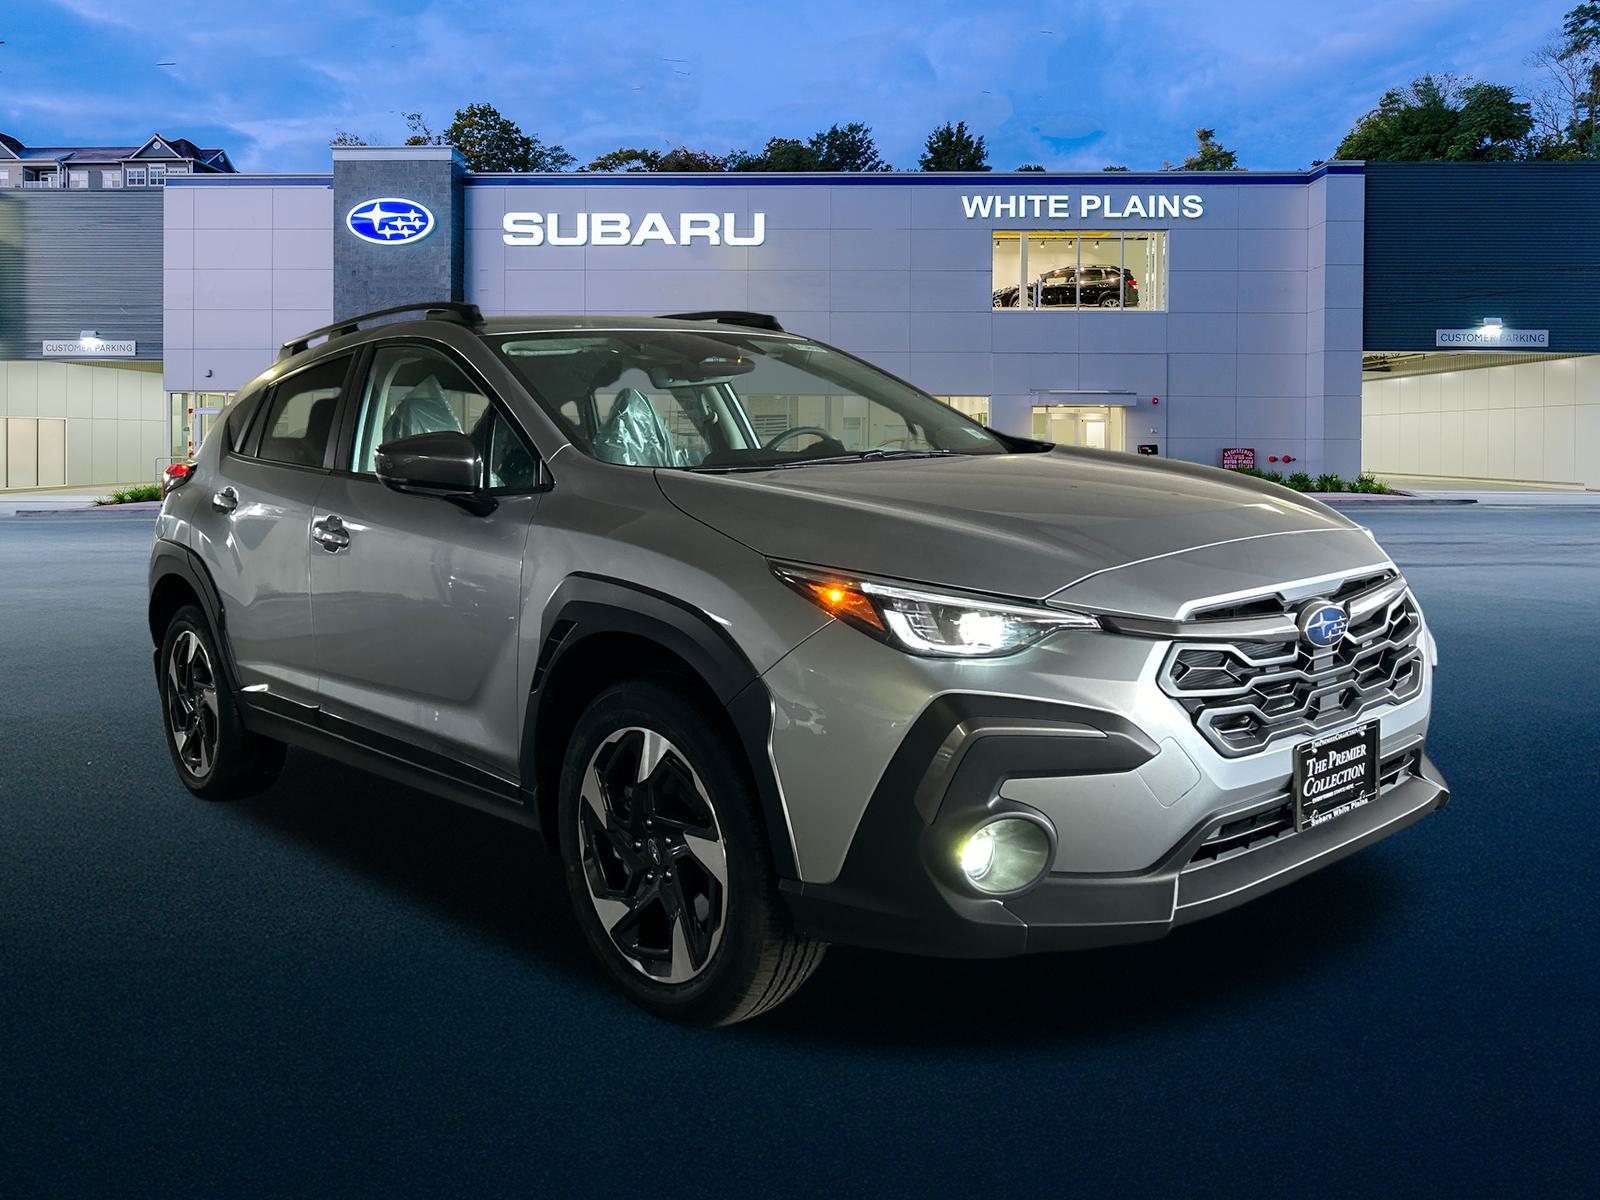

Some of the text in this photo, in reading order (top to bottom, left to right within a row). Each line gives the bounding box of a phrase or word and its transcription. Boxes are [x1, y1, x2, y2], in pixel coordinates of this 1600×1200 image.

[961, 195, 1204, 219] WHITE PLAINS
[502, 212, 766, 246] SUBARU
[45, 344, 133, 352] CUSTOMER PARKING
[1441, 333, 1545, 343] CUSTOMER PARKING
[1328, 744, 1367, 769] PREMIER
[1303, 762, 1366, 797] COLLECTION
